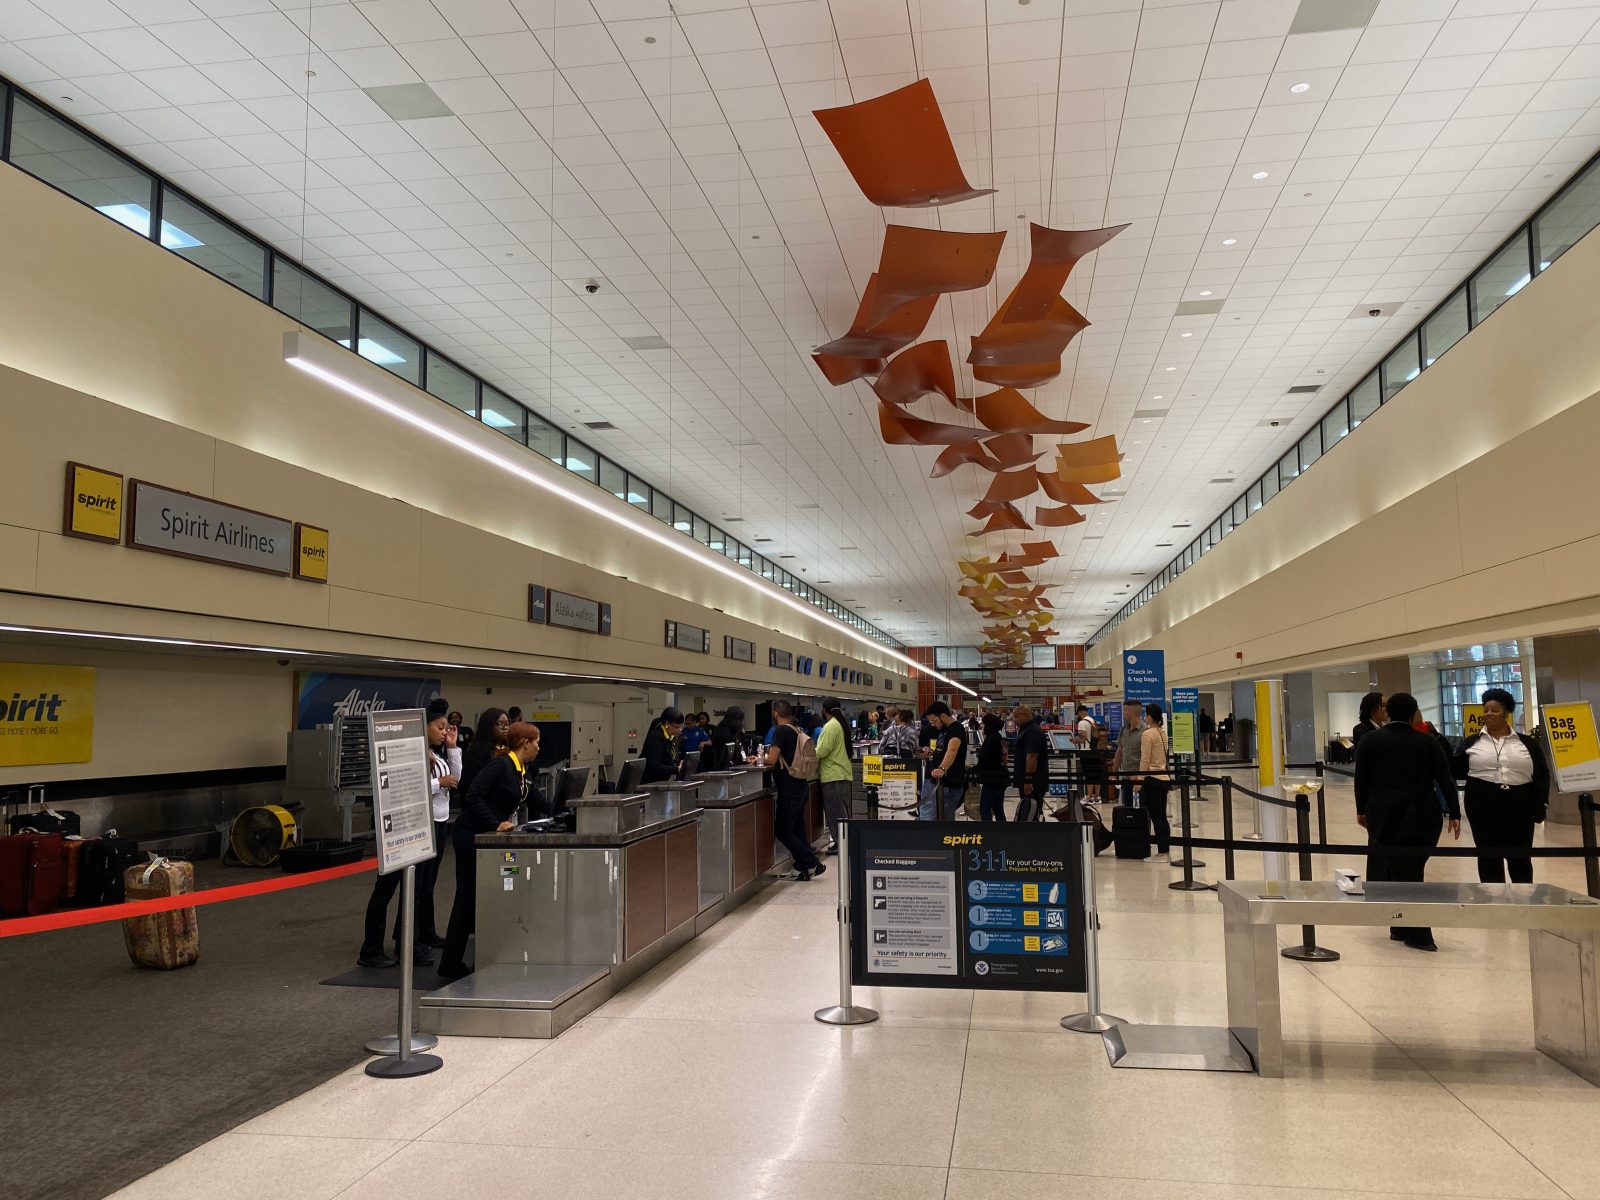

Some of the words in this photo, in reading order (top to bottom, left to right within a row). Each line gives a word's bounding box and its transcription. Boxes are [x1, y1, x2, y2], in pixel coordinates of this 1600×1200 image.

[77, 493, 117, 511] spirit
[160, 507, 209, 540] Spirit
[215, 521, 275, 554] Airlines
[302, 545, 326, 559] spirit
[555, 601, 574, 618] Alaska
[333, 688, 385, 716] Alaska
[1549, 717, 1575, 730] Bag
[1552, 731, 1577, 740] Drop
[943, 834, 983, 846] spirit
[968, 849, 1008, 872] 3-1-1
[974, 883, 982, 896] 3
